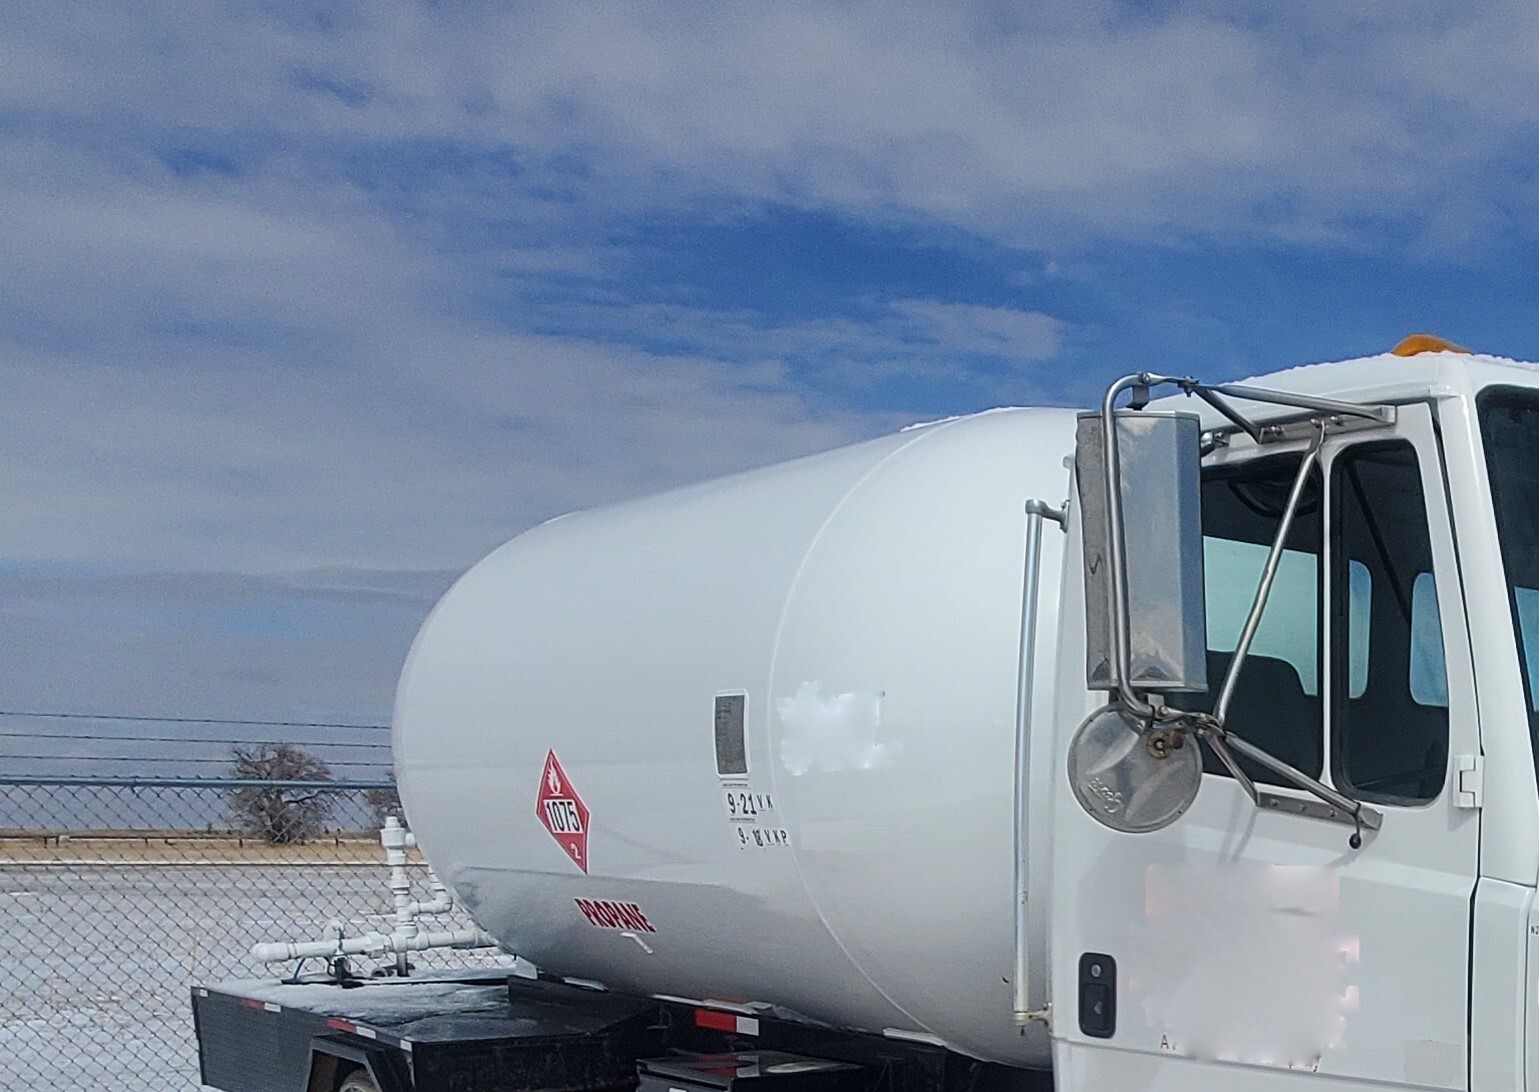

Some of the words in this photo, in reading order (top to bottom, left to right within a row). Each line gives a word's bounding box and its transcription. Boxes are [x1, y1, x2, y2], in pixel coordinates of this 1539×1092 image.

[545, 800, 580, 832] 1075
[570, 842, 581, 859] 2
[573, 898, 656, 932] PROPANE
